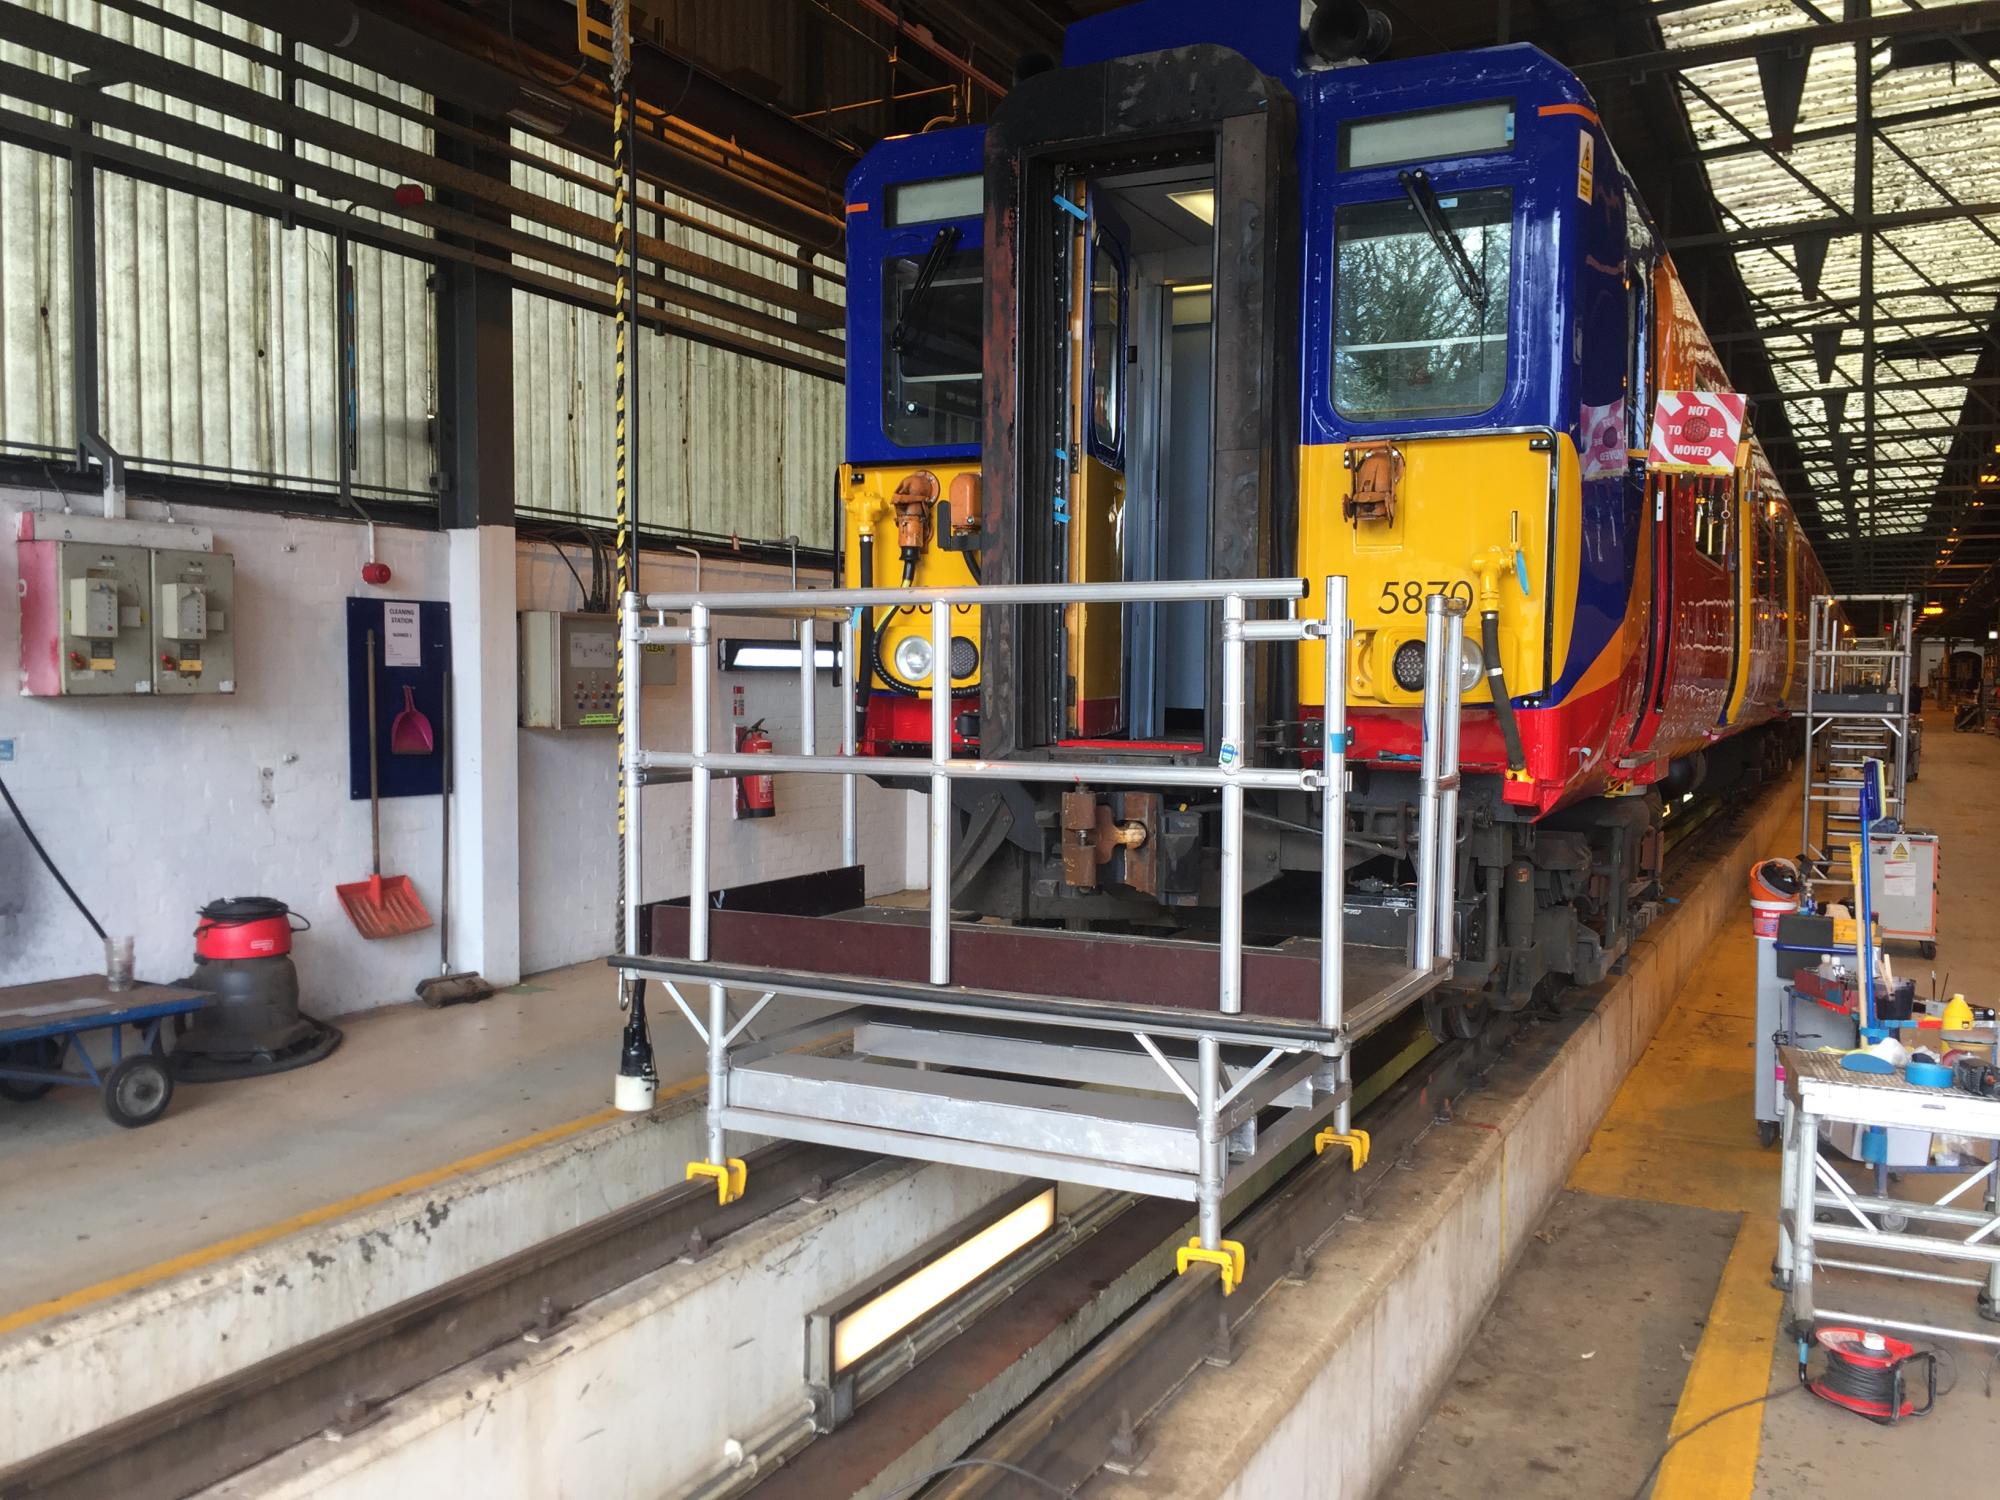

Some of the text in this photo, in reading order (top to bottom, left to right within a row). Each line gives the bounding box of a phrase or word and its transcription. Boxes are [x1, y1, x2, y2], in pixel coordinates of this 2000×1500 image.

[1688, 406, 1711, 417] NOT
[1668, 425, 1725, 438] TO BE
[1673, 444, 1712, 457] MOVED
[1378, 580, 1474, 615] 5870
[389, 608, 415, 616] CLEANING
[645, 644, 666, 652] CLEAR
